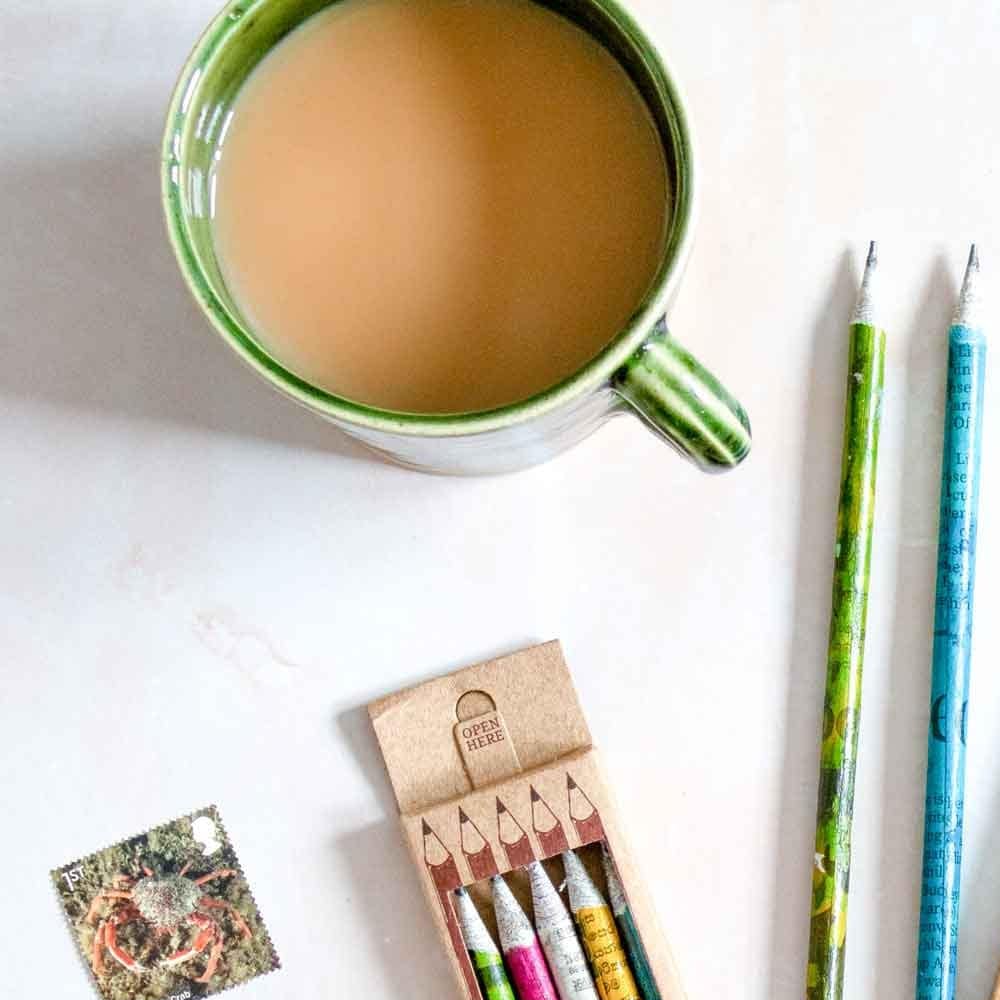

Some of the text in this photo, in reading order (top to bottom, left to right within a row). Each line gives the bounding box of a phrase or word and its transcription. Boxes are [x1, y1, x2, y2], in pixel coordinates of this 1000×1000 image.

[462, 717, 501, 738] OPEN
[466, 730, 504, 751] HERE
[61, 866, 85, 892] 1ST
